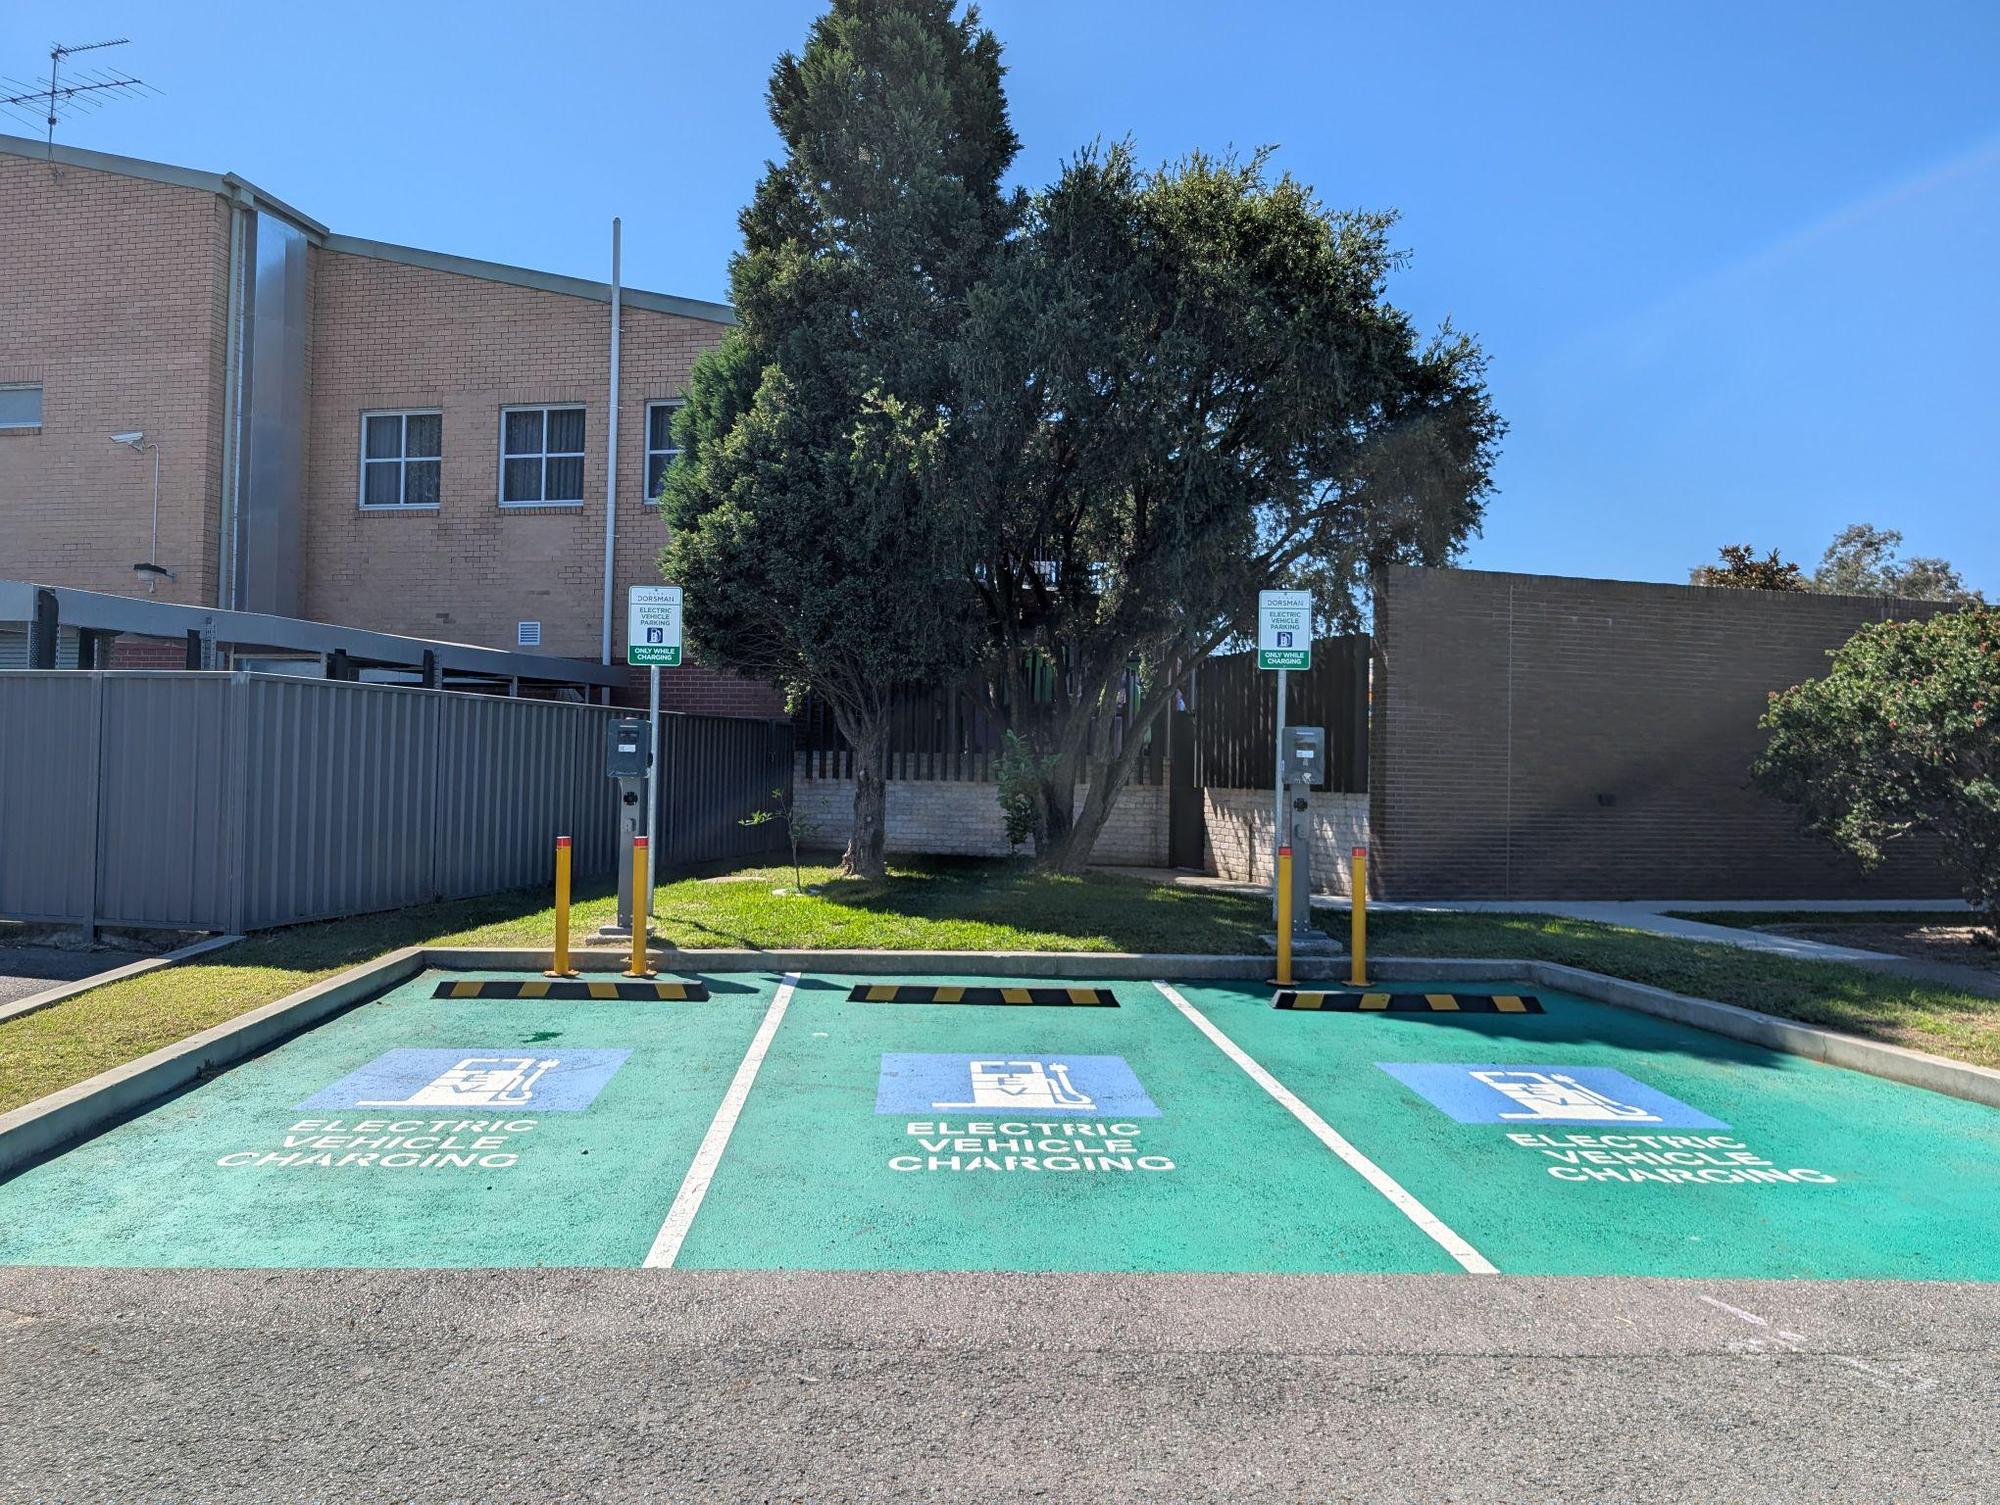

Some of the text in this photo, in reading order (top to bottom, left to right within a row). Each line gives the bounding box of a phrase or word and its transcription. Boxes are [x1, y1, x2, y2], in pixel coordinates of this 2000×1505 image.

[288, 1119, 538, 1132] ELECTRIC
[906, 1121, 1142, 1136] ELECTRIC
[281, 1135, 510, 1149] VEHICLE
[917, 1138, 1138, 1153] VEHICLE
[1505, 1133, 1747, 1149] ELECTRIC
[216, 1151, 520, 1168] CHARGING
[888, 1155, 1176, 1172] CHARGING
[1541, 1150, 1773, 1165] VEHICLE
[1546, 1166, 1838, 1184] CHARGING
